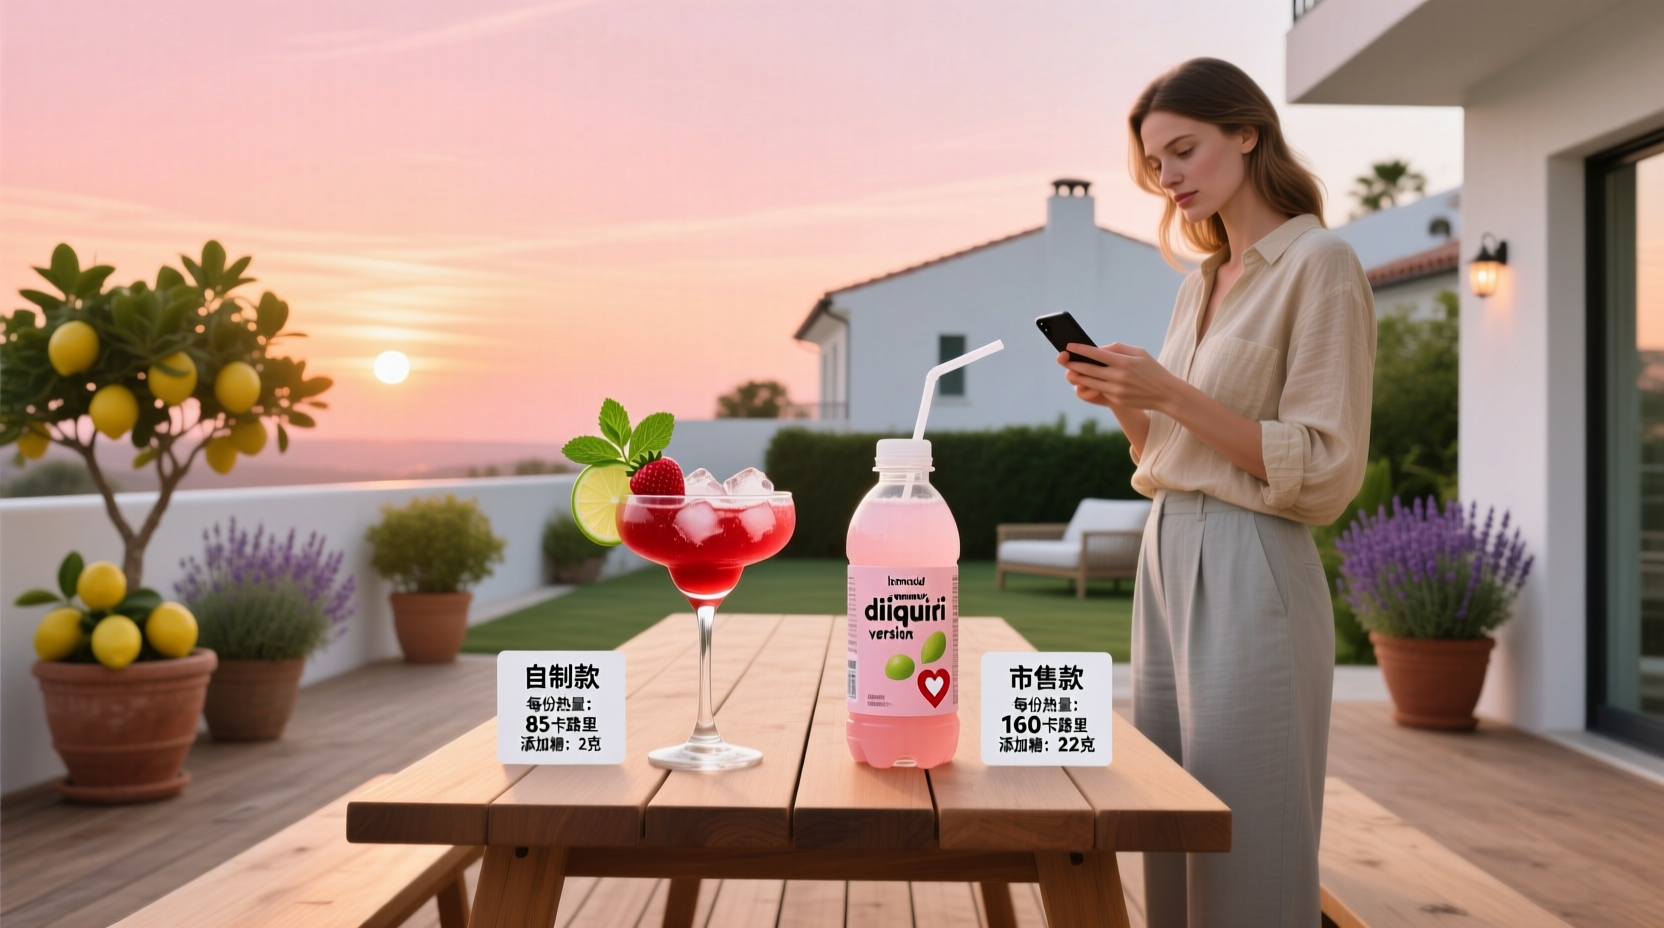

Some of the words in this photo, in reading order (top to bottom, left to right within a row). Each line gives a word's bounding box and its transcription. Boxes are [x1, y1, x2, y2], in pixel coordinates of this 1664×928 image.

[869, 626, 914, 640] version
[526, 663, 600, 689] 自制款
[1009, 664, 1084, 690] 市售款
